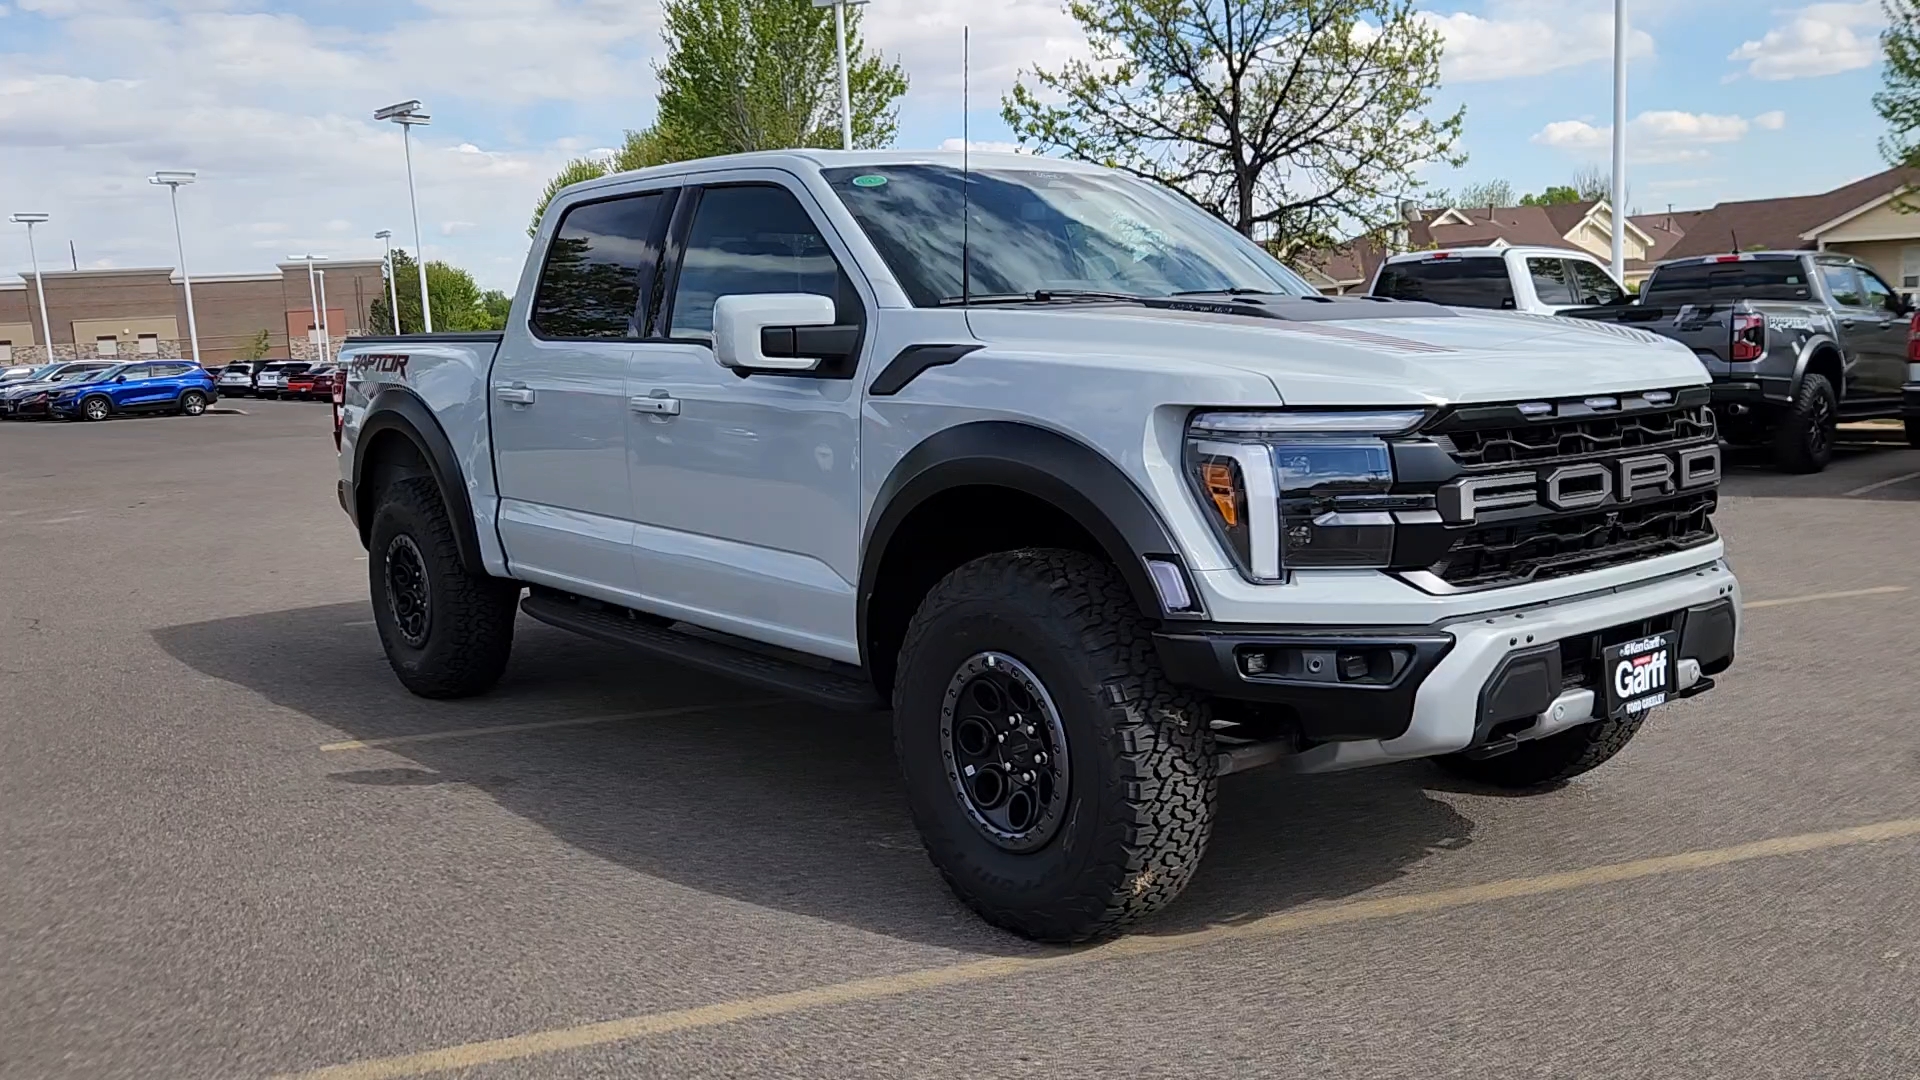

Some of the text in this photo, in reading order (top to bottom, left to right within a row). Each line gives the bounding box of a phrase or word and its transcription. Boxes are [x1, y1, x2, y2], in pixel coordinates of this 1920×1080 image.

[352, 354, 411, 381] RAPTOR
[1457, 444, 1721, 526] FORD
[1615, 650, 1667, 698] Garff
